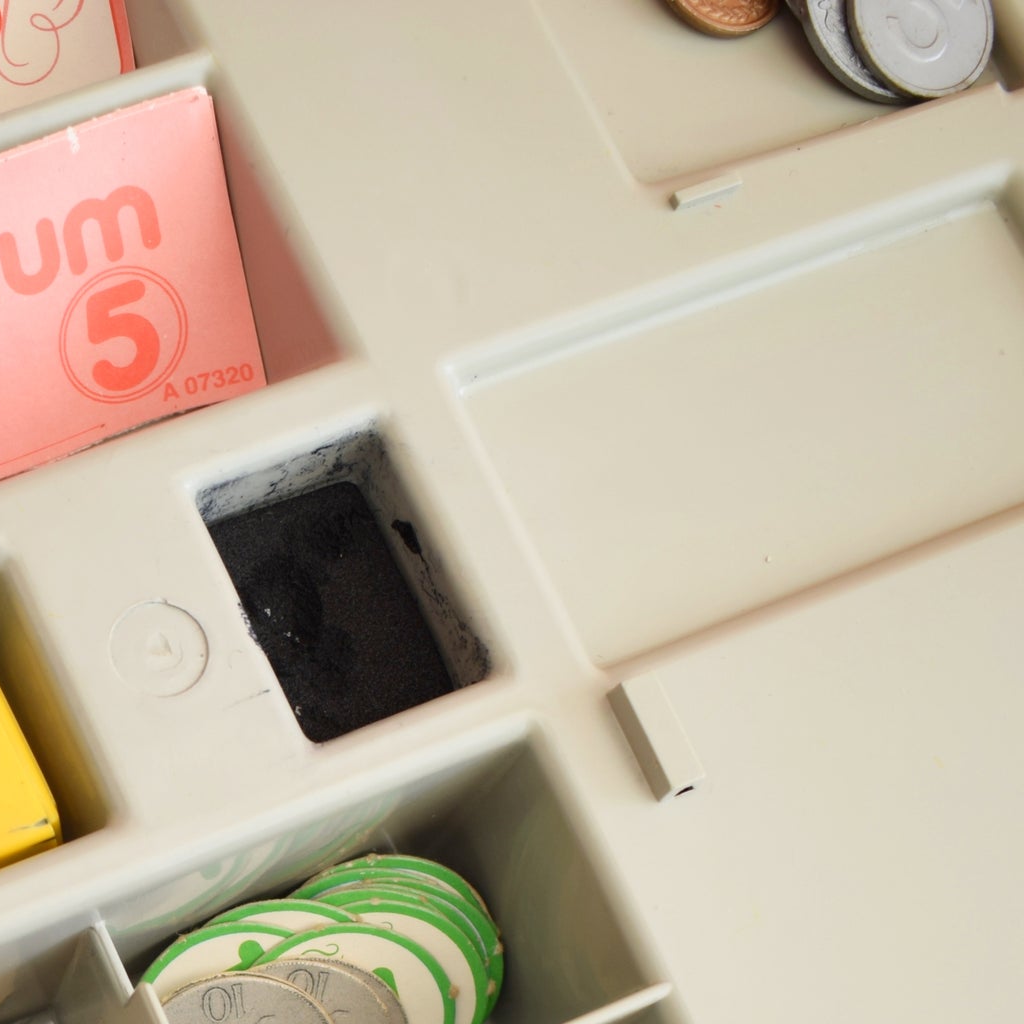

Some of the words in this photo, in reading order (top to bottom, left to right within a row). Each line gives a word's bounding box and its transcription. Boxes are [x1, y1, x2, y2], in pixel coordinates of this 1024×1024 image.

[86, 279, 160, 391] 5
[163, 382, 180, 401] A
[184, 363, 254, 395] 07320
